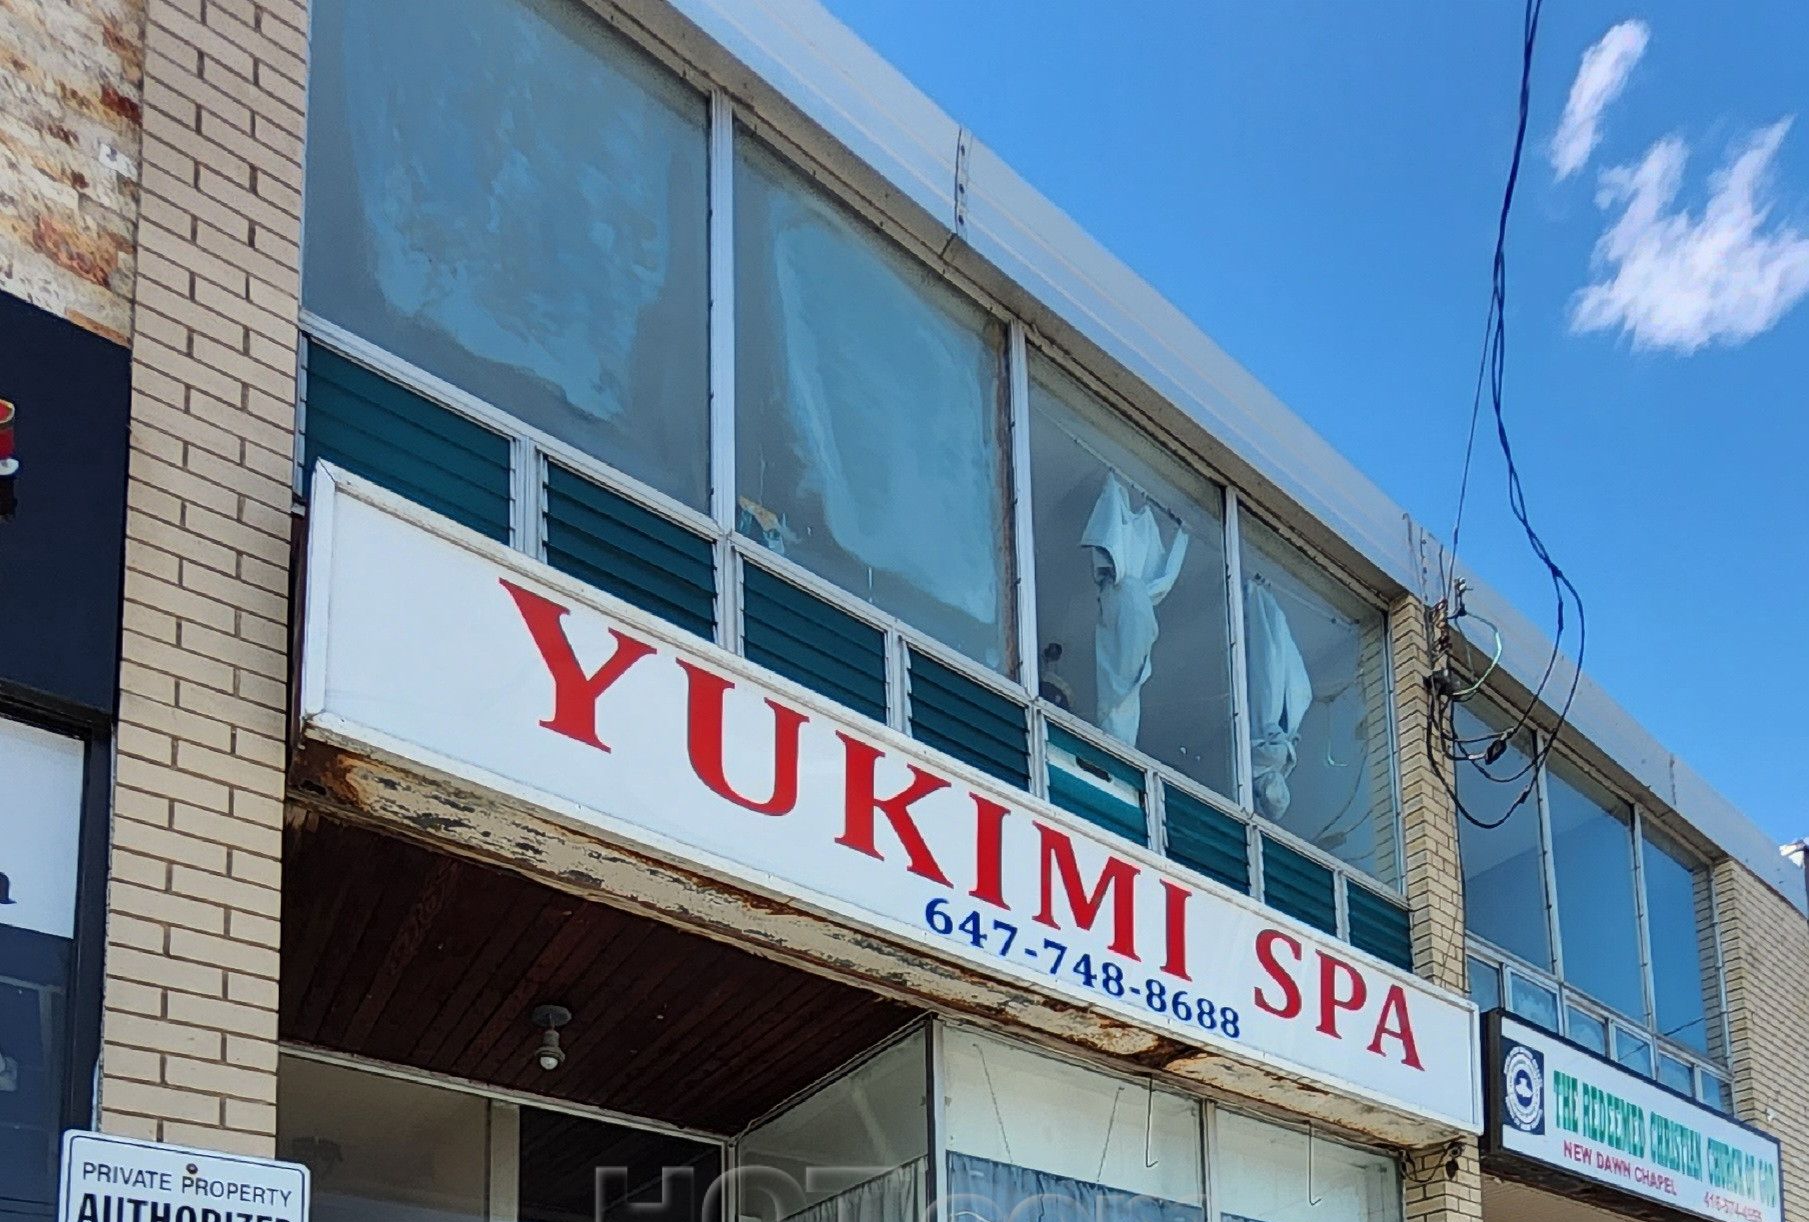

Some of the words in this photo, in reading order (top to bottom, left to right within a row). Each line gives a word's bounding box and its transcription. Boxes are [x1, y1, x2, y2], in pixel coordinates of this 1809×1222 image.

[498, 578, 1192, 982] YUKIMI
[1253, 927, 1426, 1073] SPA
[924, 897, 1242, 1039] 647-748-8688
[82, 1162, 173, 1192] PRIVATE
[181, 1175, 293, 1208] PROPERTY
[1563, 1139, 1592, 1166] NEW
[1596, 1150, 1632, 1179] DAWN
[1634, 1165, 1677, 1196] CHAPEL
